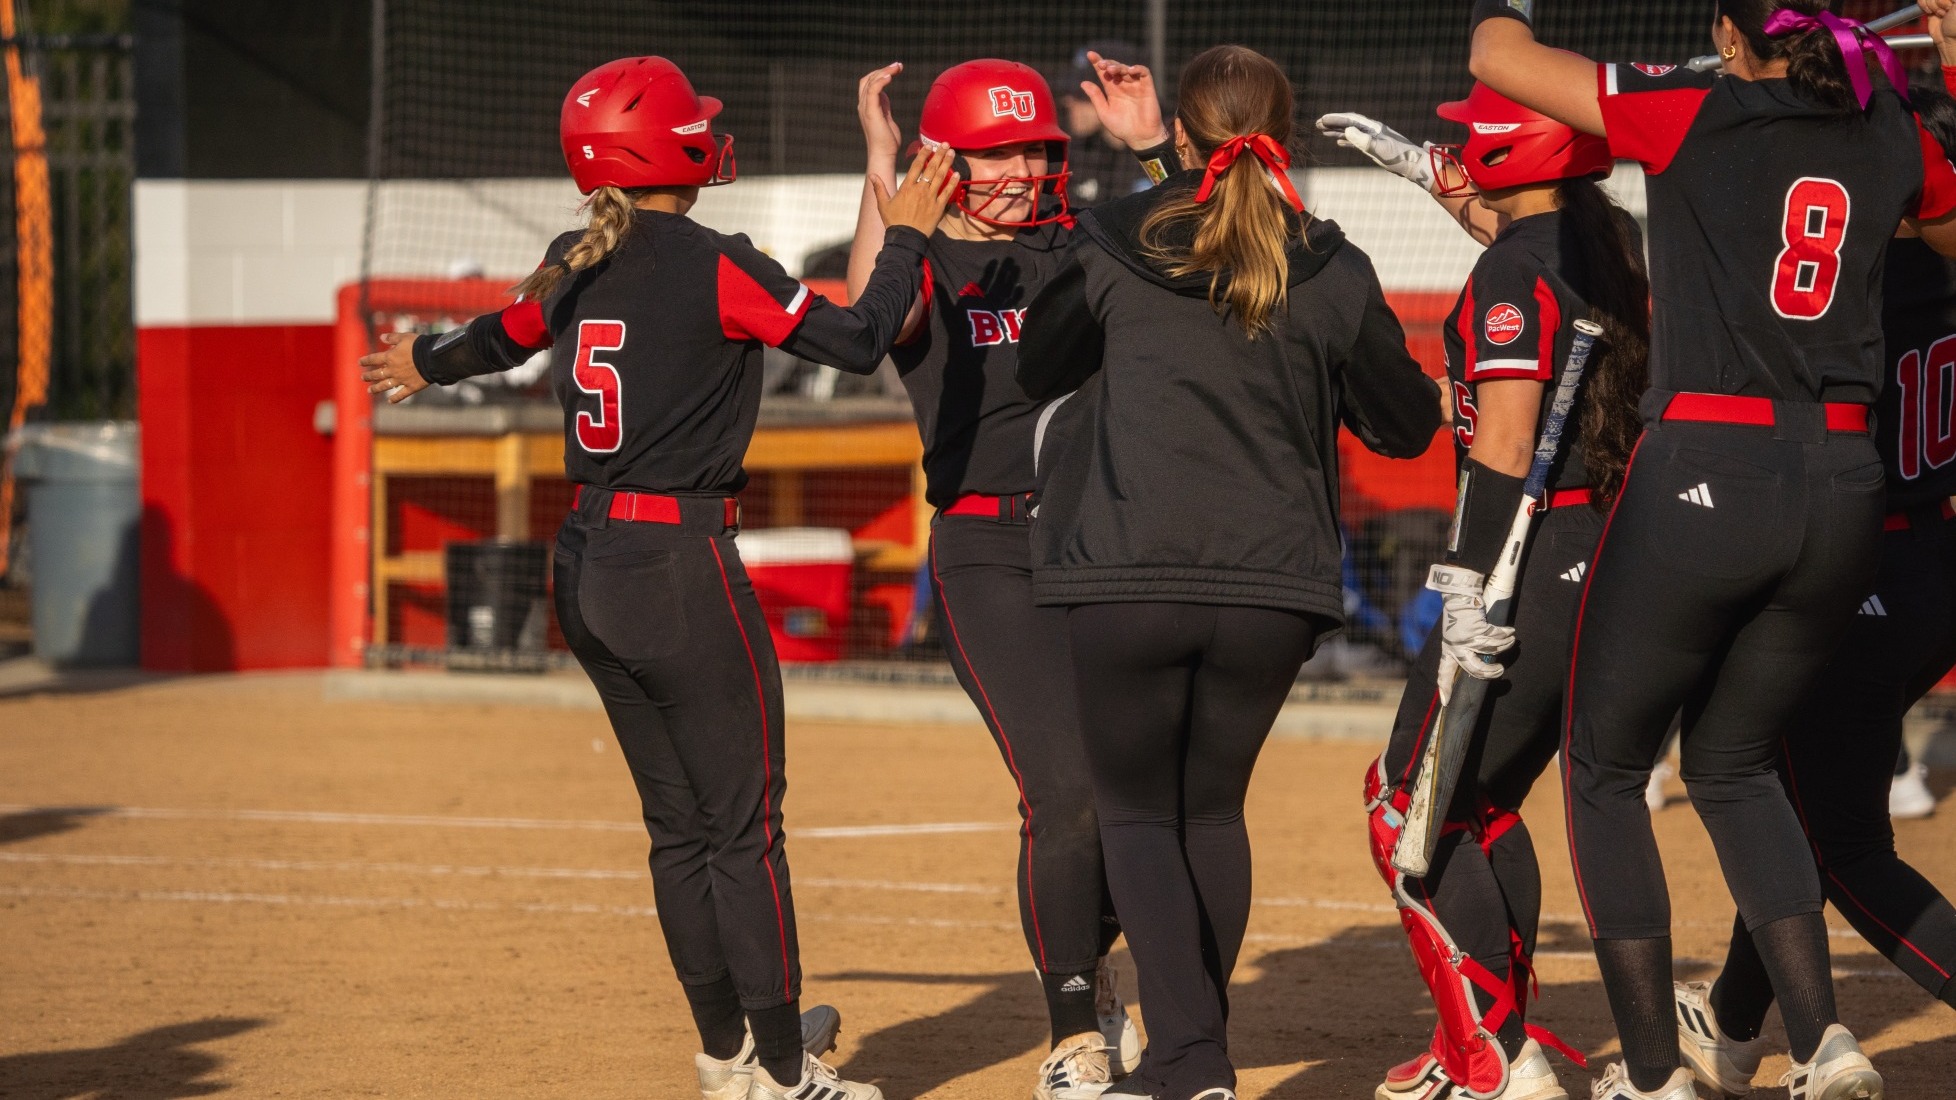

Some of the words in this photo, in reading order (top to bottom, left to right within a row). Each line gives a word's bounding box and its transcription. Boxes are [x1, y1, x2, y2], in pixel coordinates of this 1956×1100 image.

[988, 86, 1035, 121] BU
[682, 122, 705, 133] EASTON
[582, 145, 594, 159] 5
[1770, 176, 1850, 320] 8
[967, 307, 1028, 347] BI
[1488, 324, 1519, 332] PacWest
[573, 319, 626, 452] 5
[1450, 380, 1478, 448] 5
[1896, 334, 1956, 480] 10
[1061, 984, 1091, 992] adidas
